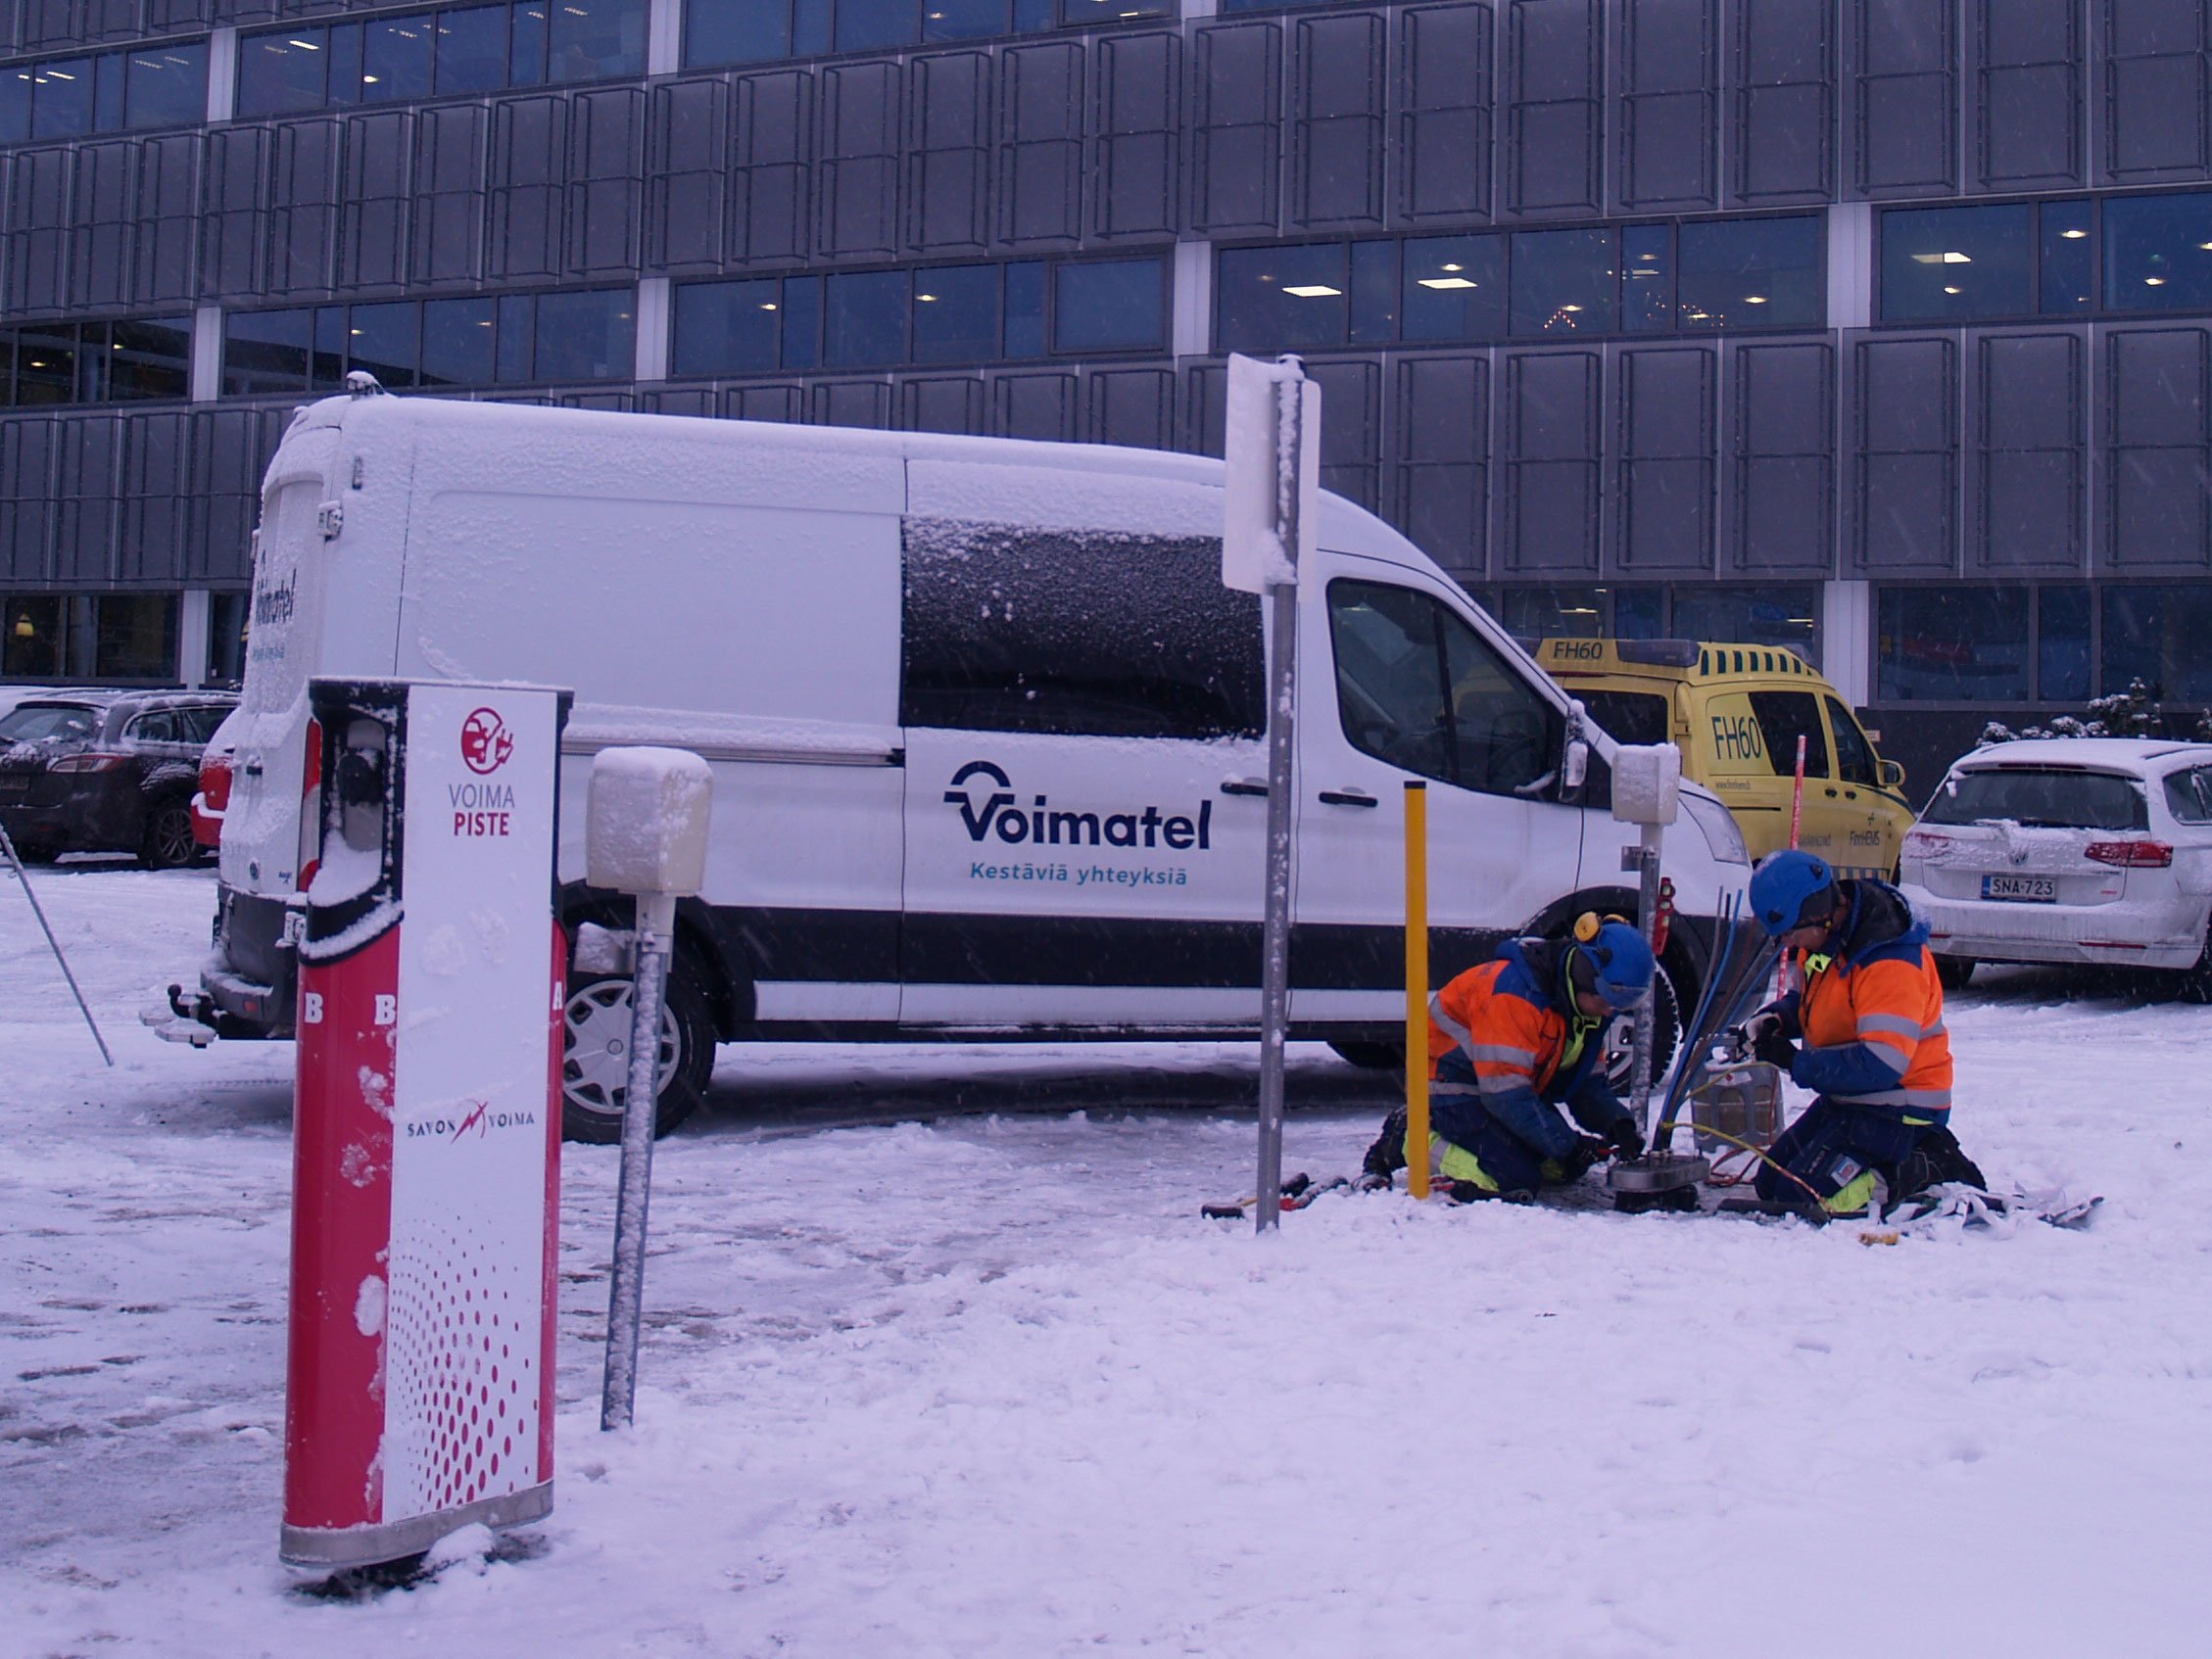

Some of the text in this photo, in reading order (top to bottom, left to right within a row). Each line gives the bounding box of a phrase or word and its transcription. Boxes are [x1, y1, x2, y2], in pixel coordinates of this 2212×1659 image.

[1554, 641, 1603, 660] FH60
[1711, 716, 1762, 760] FH60
[449, 782, 515, 809] VOIMA
[454, 812, 509, 837] PISTE
[943, 790, 1213, 850] Voimatel
[970, 862, 1187, 887] Kestäviä yhteyksiä
[1993, 878, 2053, 896] SNA-723
[305, 993, 323, 1024] B
[375, 994, 397, 1025] B
[553, 981, 563, 1011] A
[407, 1110, 535, 1138] SAVON VOIMA
